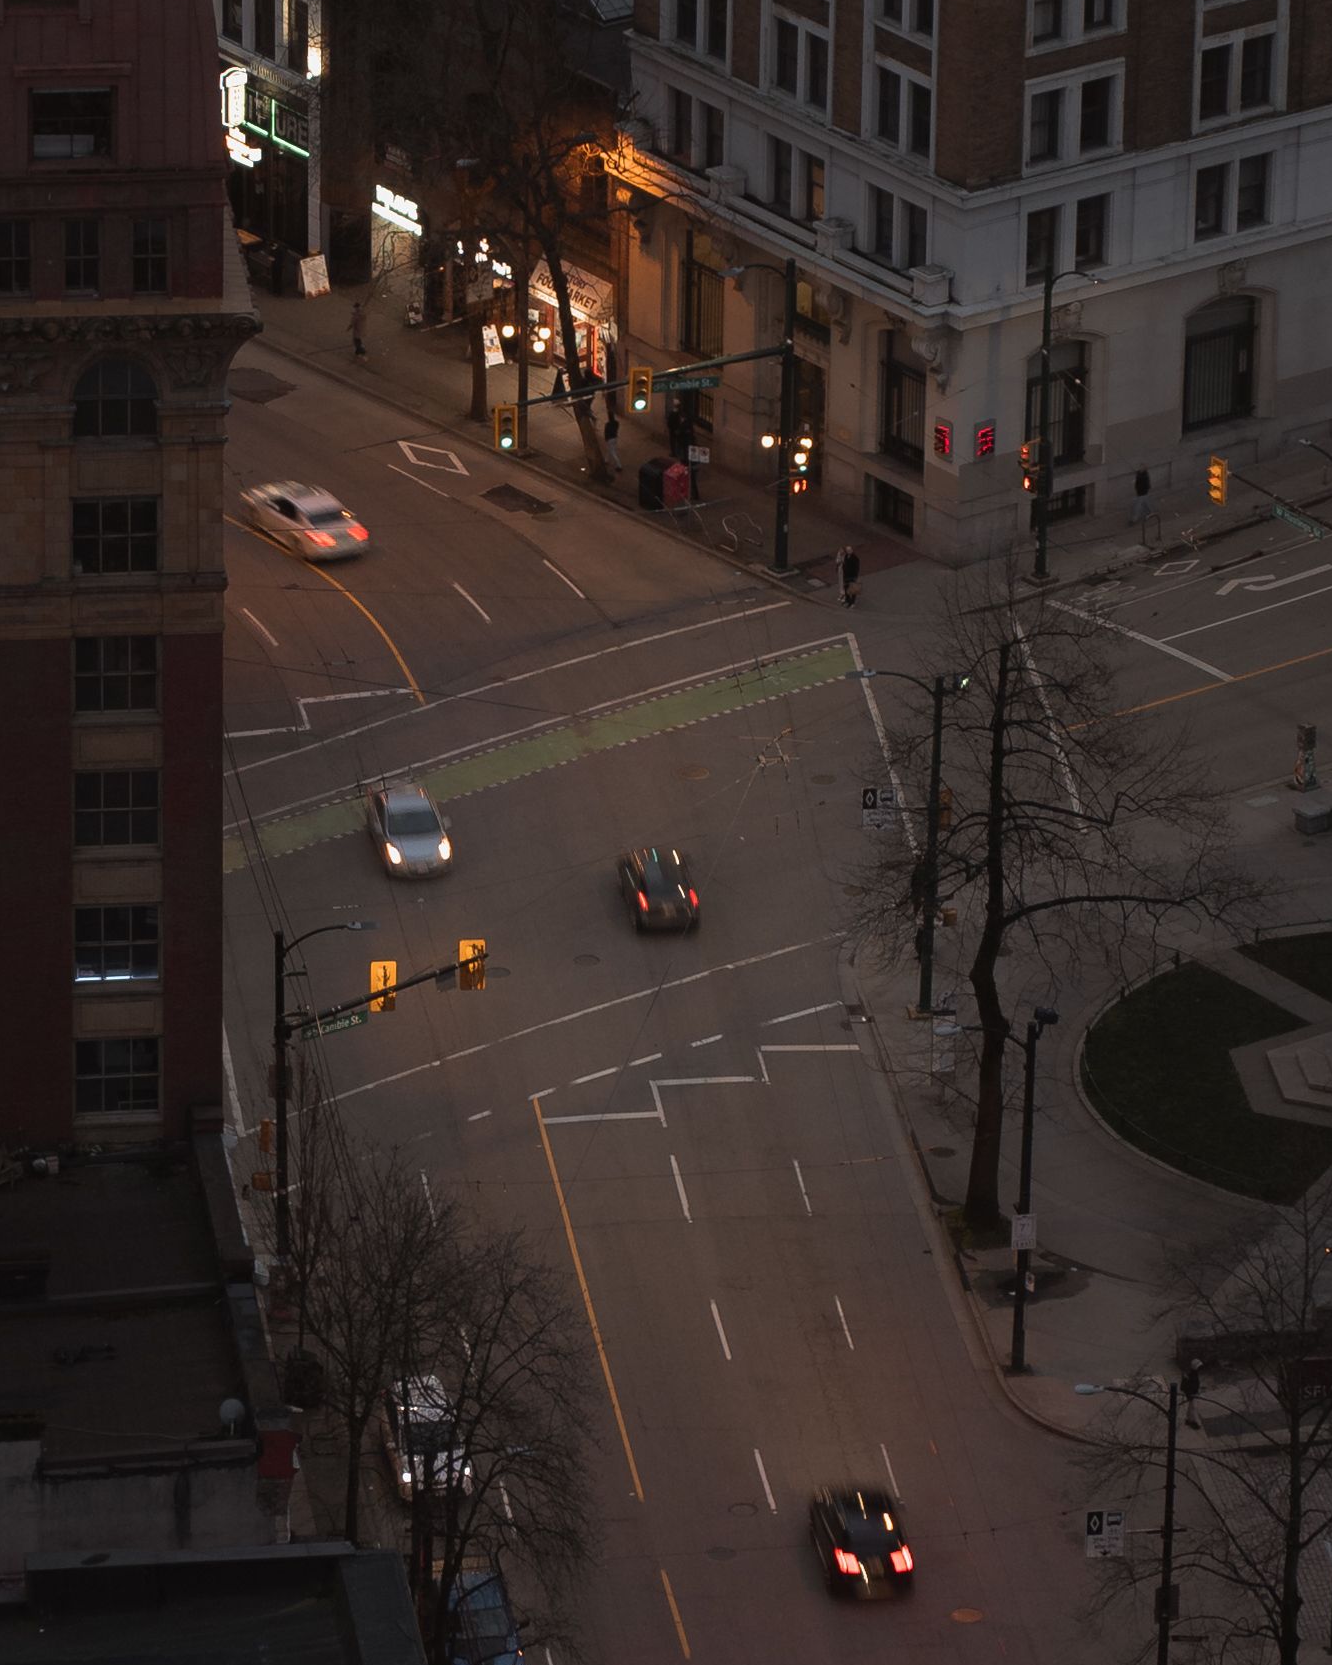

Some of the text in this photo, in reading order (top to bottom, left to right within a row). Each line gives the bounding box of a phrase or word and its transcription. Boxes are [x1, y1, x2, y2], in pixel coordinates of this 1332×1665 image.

[536, 273, 598, 311] FOO ARKET
[321, 1017, 350, 1034] Cambie
